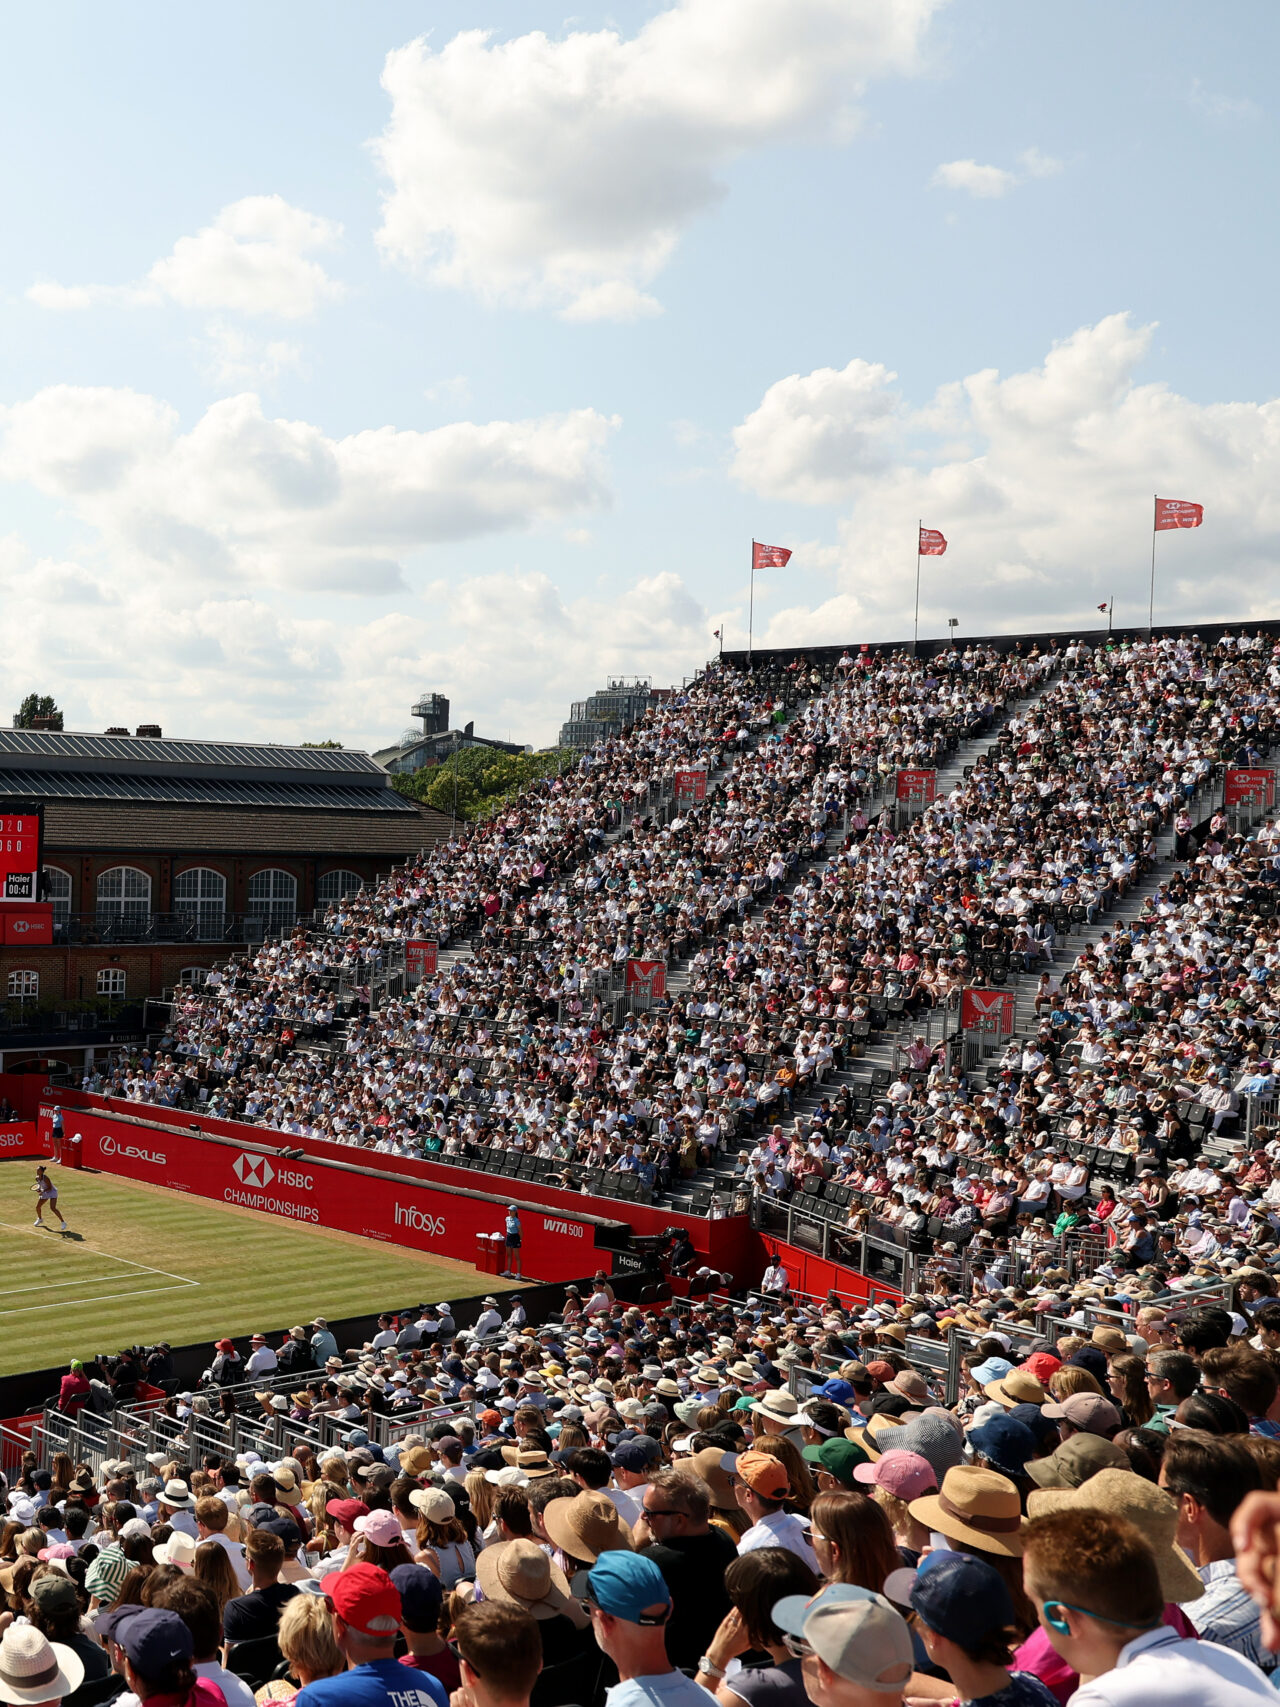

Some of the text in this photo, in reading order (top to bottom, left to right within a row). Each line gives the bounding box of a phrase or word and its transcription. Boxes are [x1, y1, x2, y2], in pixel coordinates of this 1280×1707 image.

[7, 820, 12, 832] 2
[17, 820, 22, 832] 0
[6, 840, 12, 852] 6
[8, 874, 30, 882] Haier
[8, 884, 29, 894] 00:41
[117, 1144, 167, 1165] LEXUS
[277, 1169, 314, 1190] HSBC
[224, 1188, 320, 1222] CHAMPIONSHIPS
[394, 1202, 446, 1237] Infosys
[543, 1218, 584, 1238] WTA 500
[619, 1256, 642, 1270] Haier
[386, 1690, 419, 1707] THE
